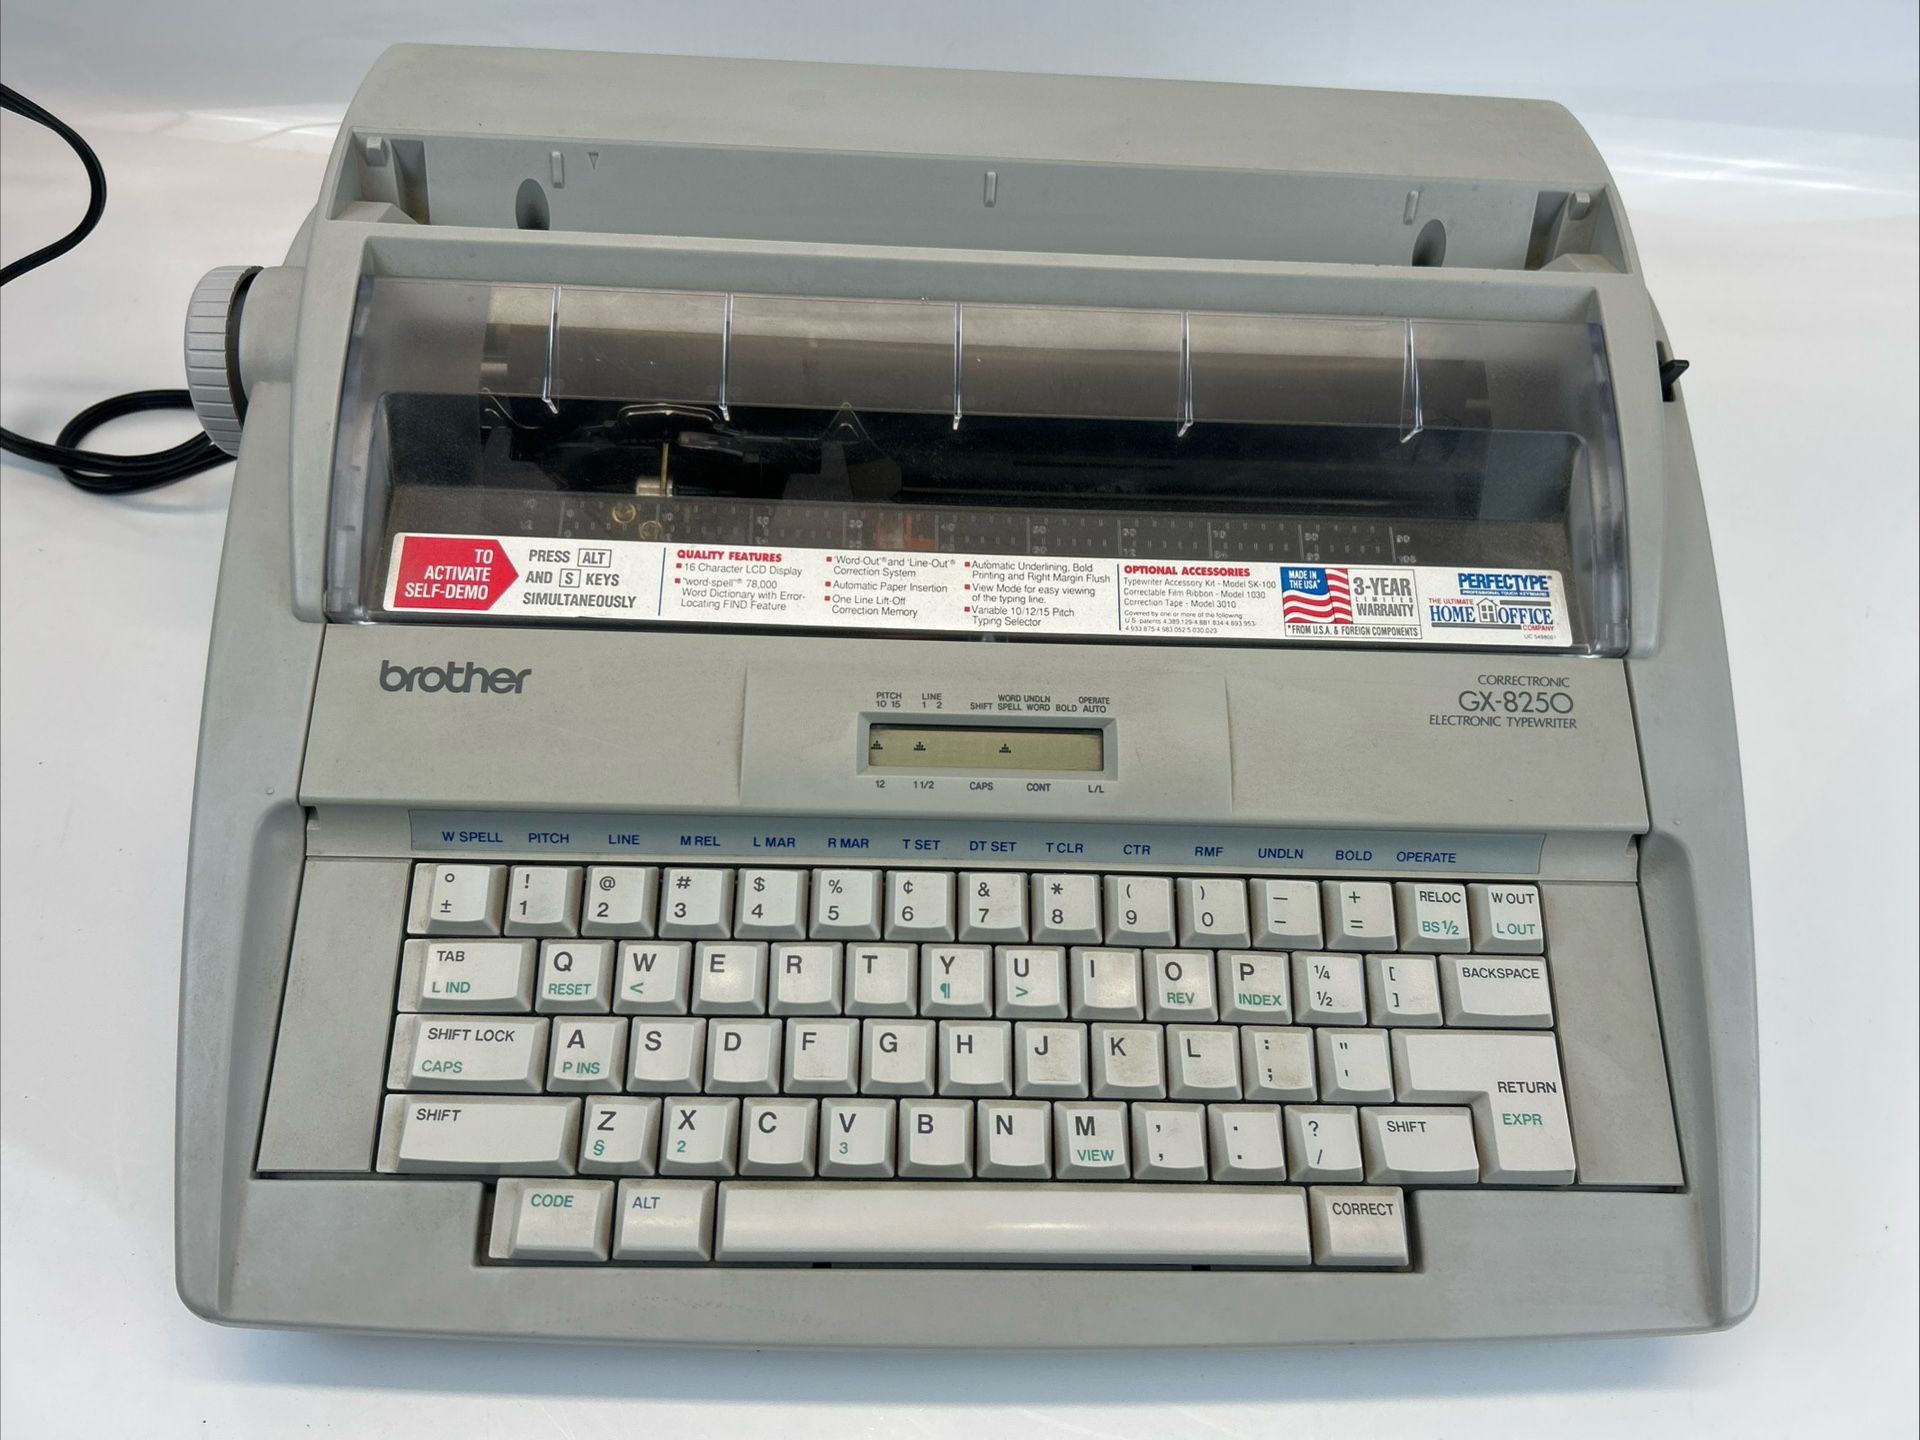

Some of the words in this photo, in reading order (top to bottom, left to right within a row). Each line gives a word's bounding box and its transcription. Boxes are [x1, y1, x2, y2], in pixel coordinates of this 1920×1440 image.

[474, 549, 494, 564] TO
[529, 549, 570, 563] PRESS
[582, 551, 606, 565] ALT
[677, 549, 725, 561] QUALITY
[729, 551, 782, 562] FEATURES
[887, 557, 905, 566] and
[685, 562, 696, 571] 16
[698, 562, 744, 574] Character
[746, 564, 767, 574] LCD
[769, 565, 802, 577] Display
[833, 566, 880, 576] Correction
[882, 567, 916, 578] System
[972, 560, 1015, 570] Automatic
[1072, 564, 1093, 573] Bold
[1124, 564, 1178, 576] OPTIONAL
[1181, 566, 1250, 577] ACCESSORIES
[424, 565, 491, 582] ACTIVATE
[525, 570, 552, 584] AND
[564, 572, 573, 585] S
[586, 573, 619, 586] KEYS
[972, 570, 1005, 582] Printing
[1008, 572, 1025, 581] and
[1027, 572, 1049, 583] Right
[1052, 573, 1083, 584] Margin
[1086, 574, 1110, 583] Flush
[1289, 570, 1307, 579] MADE
[1309, 571, 1317, 580] IN
[746, 579, 777, 589] 78,000
[833, 580, 877, 590] Automatic
[880, 582, 907, 592] Paper
[909, 583, 948, 592] Insertion
[1123, 578, 1162, 589] Typewriter
[1164, 579, 1202, 589] Accessory
[1205, 580, 1216, 588] Kit
[1223, 580, 1246, 589] Model
[1248, 580, 1276, 589] SK-100
[1290, 579, 1302, 589] THE
[1354, 577, 1411, 597] 3-YEAR
[404, 582, 489, 600] SELF-DEMO
[682, 588, 709, 597] Word
[712, 589, 755, 601] Dictionary
[758, 590, 777, 600] with
[780, 591, 806, 601] Error-
[972, 583, 994, 593] View
[996, 584, 1021, 594] Mode
[1024, 585, 1036, 594] for
[1038, 587, 1059, 597] easy
[1061, 586, 1096, 597] viewing
[1123, 588, 1169, 597] Correctable
[1168, 589, 1184, 597] Film
[1187, 590, 1213, 598] Ribbon
[1221, 590, 1245, 599] Model
[1247, 590, 1266, 599] 1030
[523, 592, 637, 608] SIMULTANEOUSLY
[681, 599, 721, 610] Locating
[723, 600, 747, 609] FIND
[751, 601, 786, 611] Feature
[832, 594, 852, 604] One
[855, 595, 873, 604] Line
[876, 596, 906, 605] Lift-Off
[972, 593, 981, 603] of
[983, 594, 997, 603] the
[999, 595, 1026, 605] typing
[1029, 595, 1046, 604] line.
[1123, 598, 1164, 606] Correction
[1166, 599, 1183, 609] Tape
[1190, 600, 1214, 608] Model
[1216, 600, 1236, 609] 3010
[832, 605, 878, 615] Correction
[881, 607, 918, 618] Memory
[971, 605, 1008, 615] Variable
[1011, 606, 1049, 616] 10/12/15
[1053, 607, 1075, 617] Pitch
[1356, 603, 1414, 617] WARRANTY
[1429, 605, 1476, 623] HOME
[1499, 607, 1554, 625] OFFICE
[972, 616, 1002, 627] Typing
[1004, 617, 1041, 627] Selector
[1313, 625, 1331, 635] U.S.A.
[1341, 626, 1370, 636] FOREIGN
[1372, 626, 1418, 637] COMPONENTS
[1522, 624, 1554, 632] COMPANY
[379, 660, 532, 694] brother
[1478, 674, 1570, 687] CORRECTRONIC
[876, 691, 902, 700] PITCH
[921, 693, 942, 701] LINE
[998, 694, 1022, 702] WORD
[1023, 695, 1051, 703] UNDLN
[1078, 696, 1111, 705] OPERATE
[970, 702, 993, 711] SHIFT
[998, 703, 1022, 712] SPELL
[1026, 703, 1050, 712] WORD
[1056, 704, 1077, 712] BOLD
[1458, 690, 1574, 714] GX-8250
[1082, 704, 1107, 713] AUTO
[1429, 714, 1501, 727] ELECTRONIC
[1506, 717, 1577, 729] TYPEWRITER
[969, 782, 994, 791] CAPS
[1026, 783, 1051, 792] CONT
[1088, 785, 1105, 794] L/L
[442, 831, 455, 842] W
[459, 832, 503, 843] SPELL
[528, 832, 569, 844] PITCH
[608, 834, 640, 845] LINE
[680, 835, 692, 846] M
[694, 835, 721, 847] REL
[753, 837, 761, 847] L
[765, 837, 796, 848] MAR
[828, 838, 837, 848] R
[840, 838, 869, 849] MAR
[903, 839, 911, 849] T
[914, 839, 941, 850] SET
[970, 840, 987, 851] DT
[991, 841, 1017, 852] SET
[1046, 842, 1054, 852] T
[1057, 843, 1084, 853] CLR
[1123, 844, 1151, 855] CTR
[1195, 847, 1224, 857] RMF
[1258, 848, 1303, 860] UNDLN
[1335, 850, 1373, 861] BOLD
[1396, 851, 1457, 863] OPERATE
[1419, 890, 1462, 904] RELOC
[1506, 893, 1535, 905] OUT
[1422, 920, 1439, 933] BS
[1507, 923, 1536, 935] OUT
[436, 950, 465, 962] TAB
[1462, 967, 1540, 980] BACKSPACE
[445, 981, 471, 994] IND
[548, 983, 591, 995] RESET
[1166, 992, 1195, 1004] REV
[1238, 993, 1282, 1006] INDEX
[427, 1028, 471, 1041] SHIFT
[475, 1029, 515, 1042] LOCK
[421, 1060, 463, 1073] CAPS
[576, 1062, 600, 1074] INS
[1497, 1081, 1557, 1094] RETURN
[415, 1109, 462, 1122] SHIFT
[1502, 1114, 1543, 1126] EXPR
[1386, 1120, 1426, 1133] SHIFT
[1077, 1149, 1115, 1162] VIEW
[530, 1194, 574, 1208] CODE
[632, 1196, 660, 1209] ALT
[1332, 1203, 1394, 1216] CORRECT
